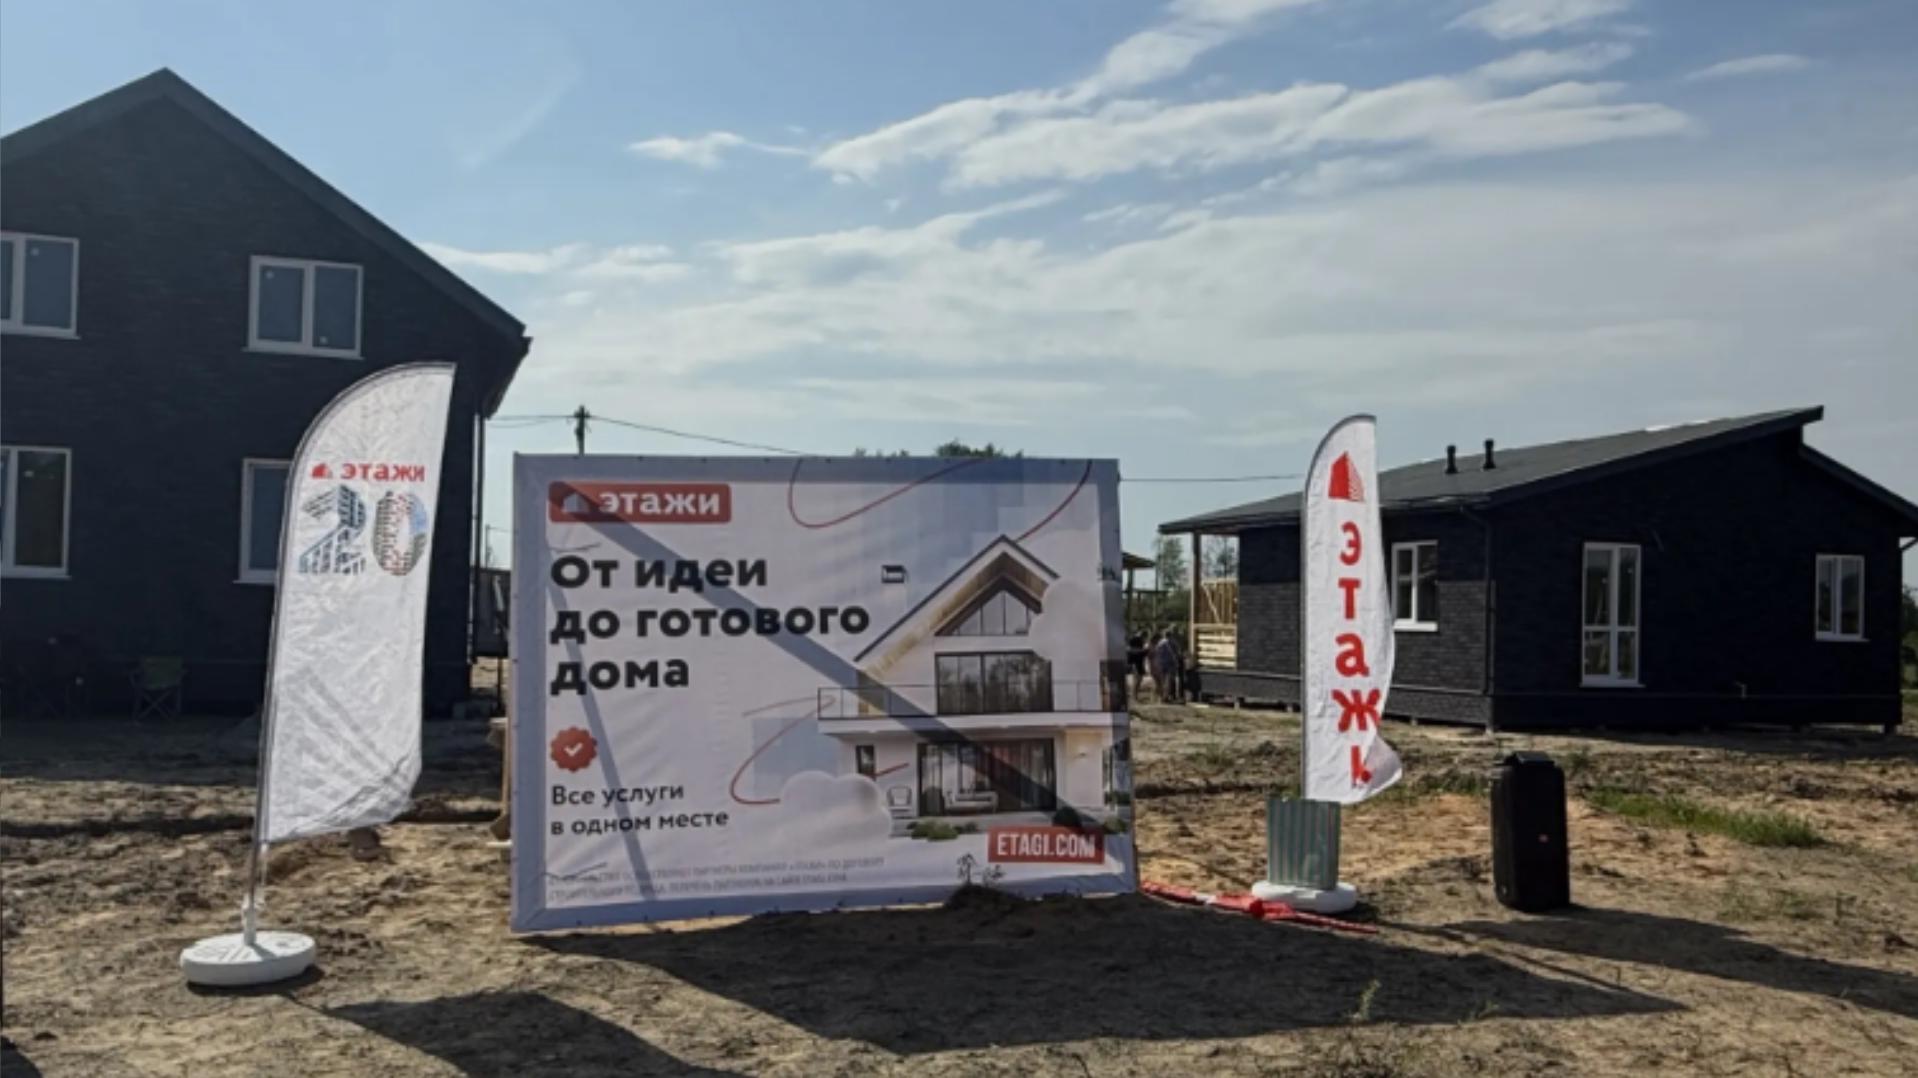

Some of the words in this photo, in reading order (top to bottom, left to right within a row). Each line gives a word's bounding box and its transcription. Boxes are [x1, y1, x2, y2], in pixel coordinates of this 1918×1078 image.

[341, 463, 425, 481] этажи
[600, 492, 719, 515] этажи
[298, 485, 428, 576] 20
[551, 555, 619, 588] От
[635, 559, 767, 594] идеи
[550, 608, 620, 644] до
[636, 605, 870, 638] готового
[550, 658, 689, 695] дома
[552, 785, 595, 805] Все
[602, 785, 684, 808] услуги
[551, 821, 564, 835] в
[571, 816, 651, 835] одном
[659, 811, 729, 830] месте
[997, 832, 1096, 858] ETAGI.COM
